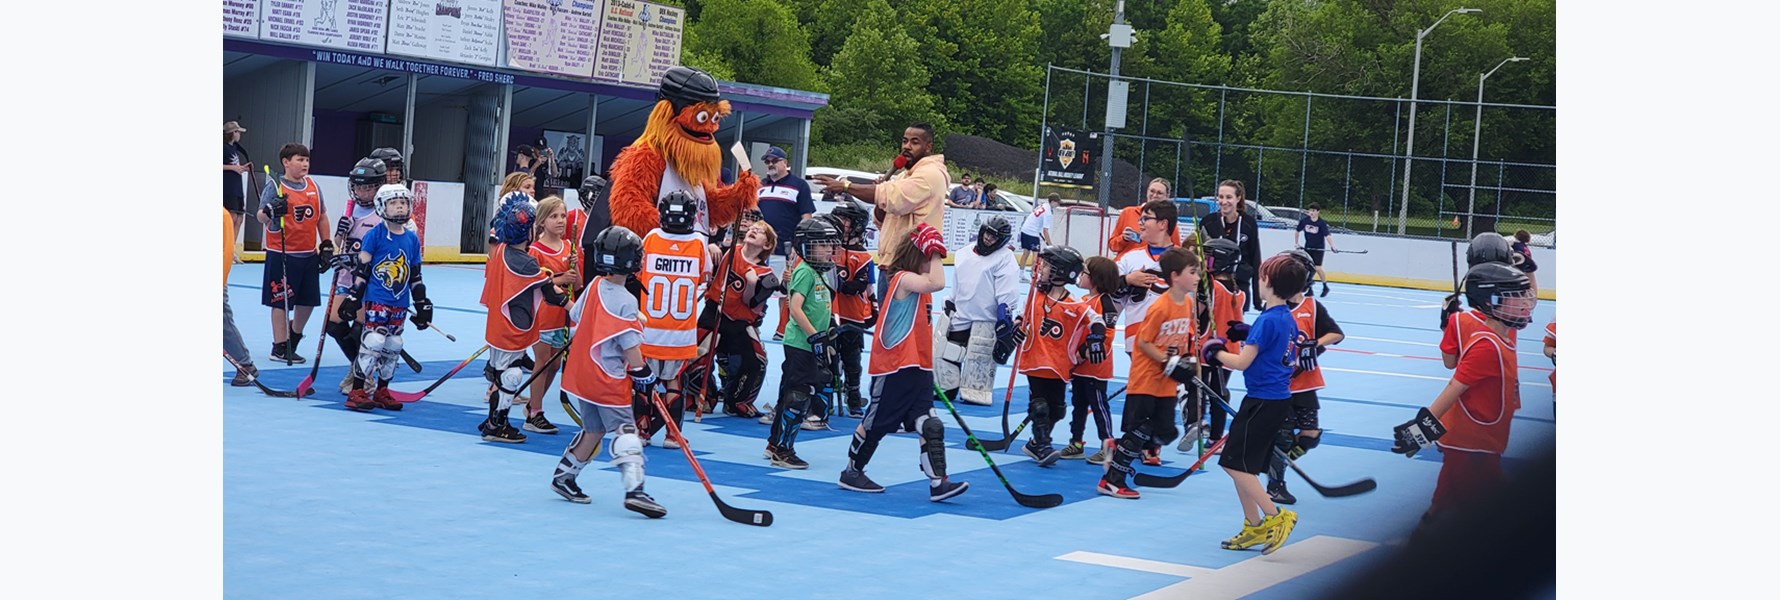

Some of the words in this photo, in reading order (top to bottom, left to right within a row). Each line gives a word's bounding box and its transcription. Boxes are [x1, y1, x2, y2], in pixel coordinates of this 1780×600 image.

[332, 53, 357, 65] TODAY
[373, 58, 384, 68] WE
[384, 60, 405, 72] WALK
[405, 61, 439, 75] TOGETHER
[477, 71, 494, 82] FRED
[655, 257, 692, 273] GRITTY
[646, 275, 695, 321] 00
[1422, 416, 1440, 435] Mylec
